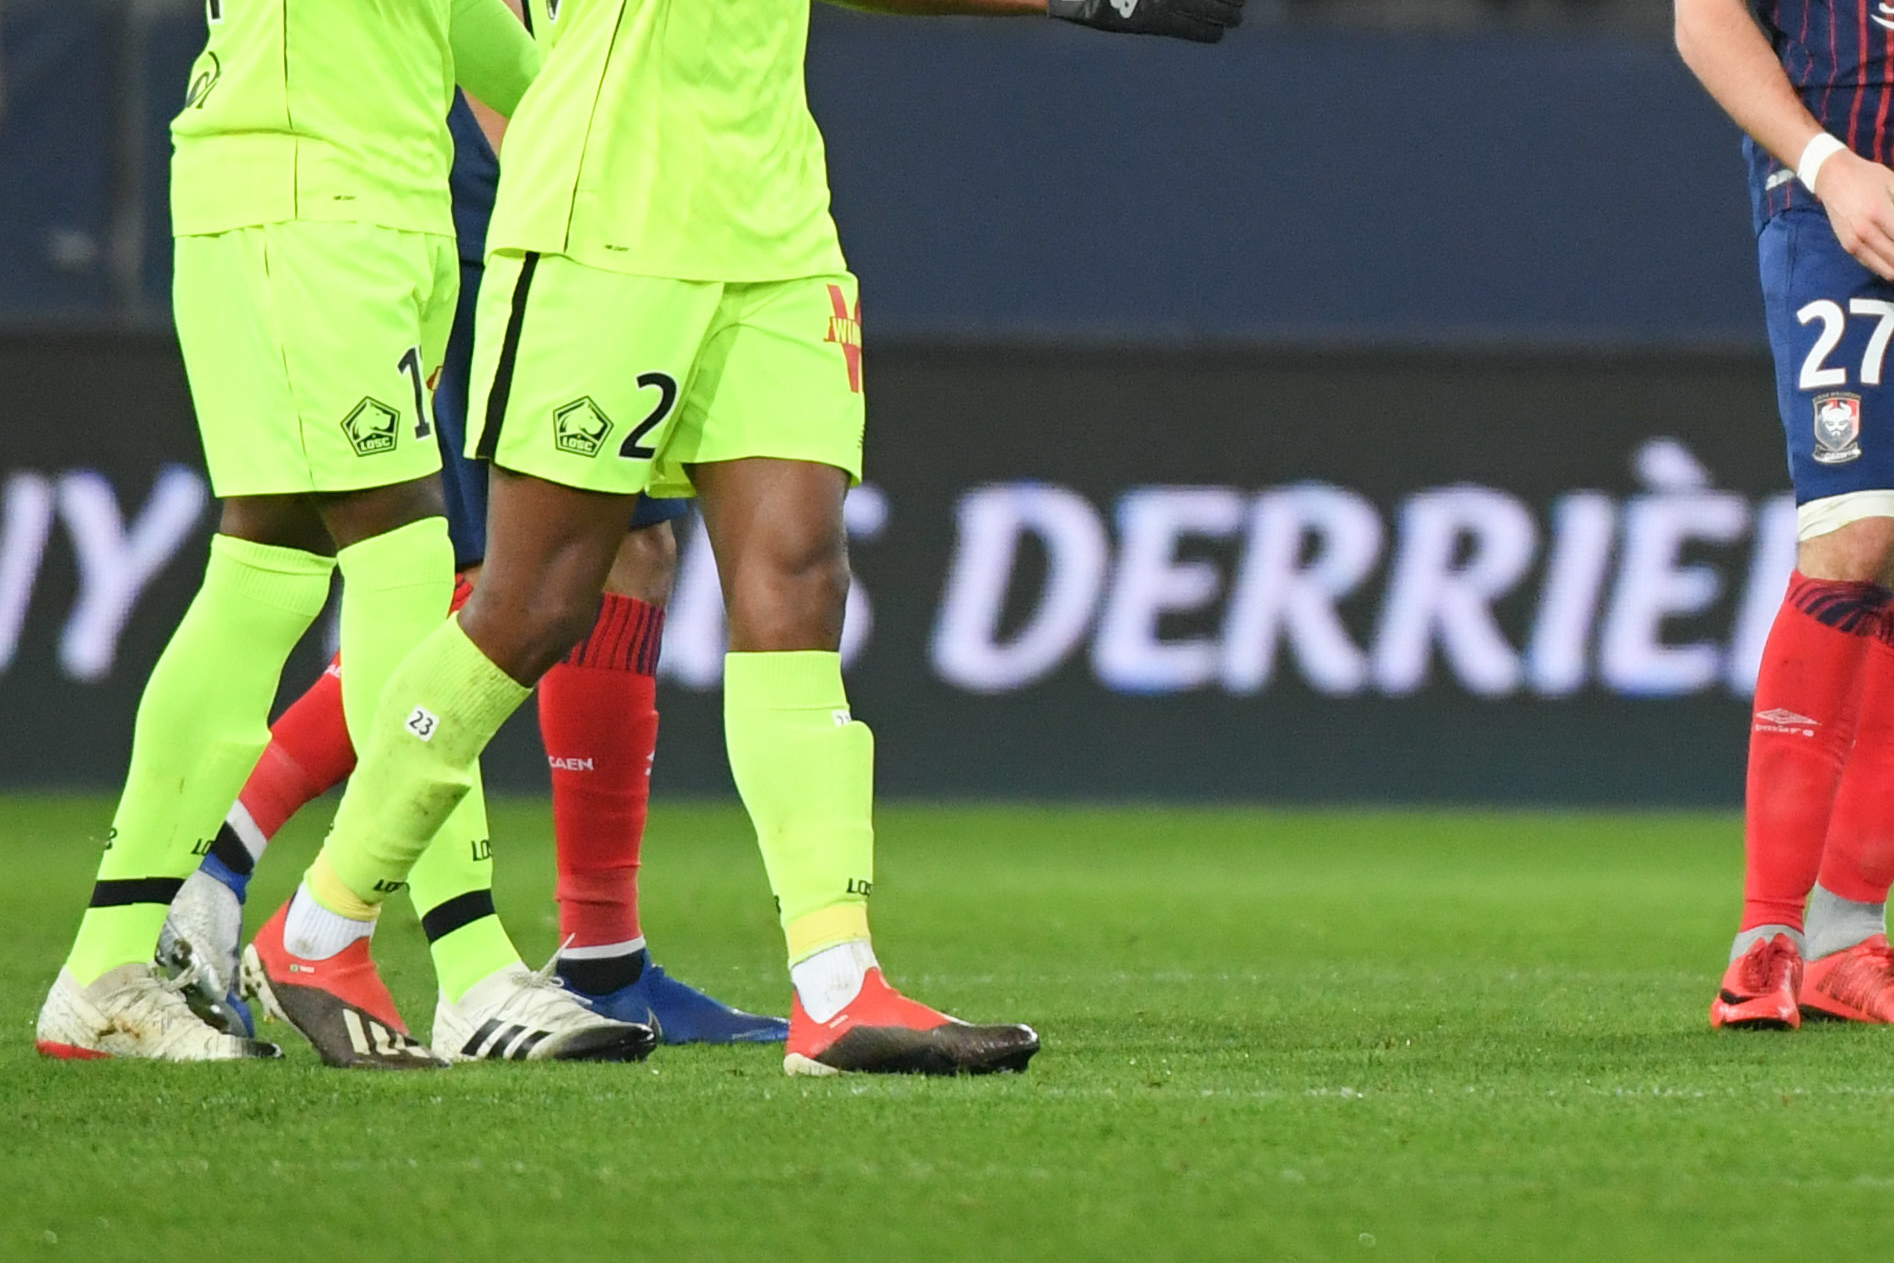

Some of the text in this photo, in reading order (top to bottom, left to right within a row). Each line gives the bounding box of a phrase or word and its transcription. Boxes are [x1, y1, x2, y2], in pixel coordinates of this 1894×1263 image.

[360, 438, 392, 451] LOSC
[562, 438, 594, 452] LOSC
[408, 711, 435, 737] 23
